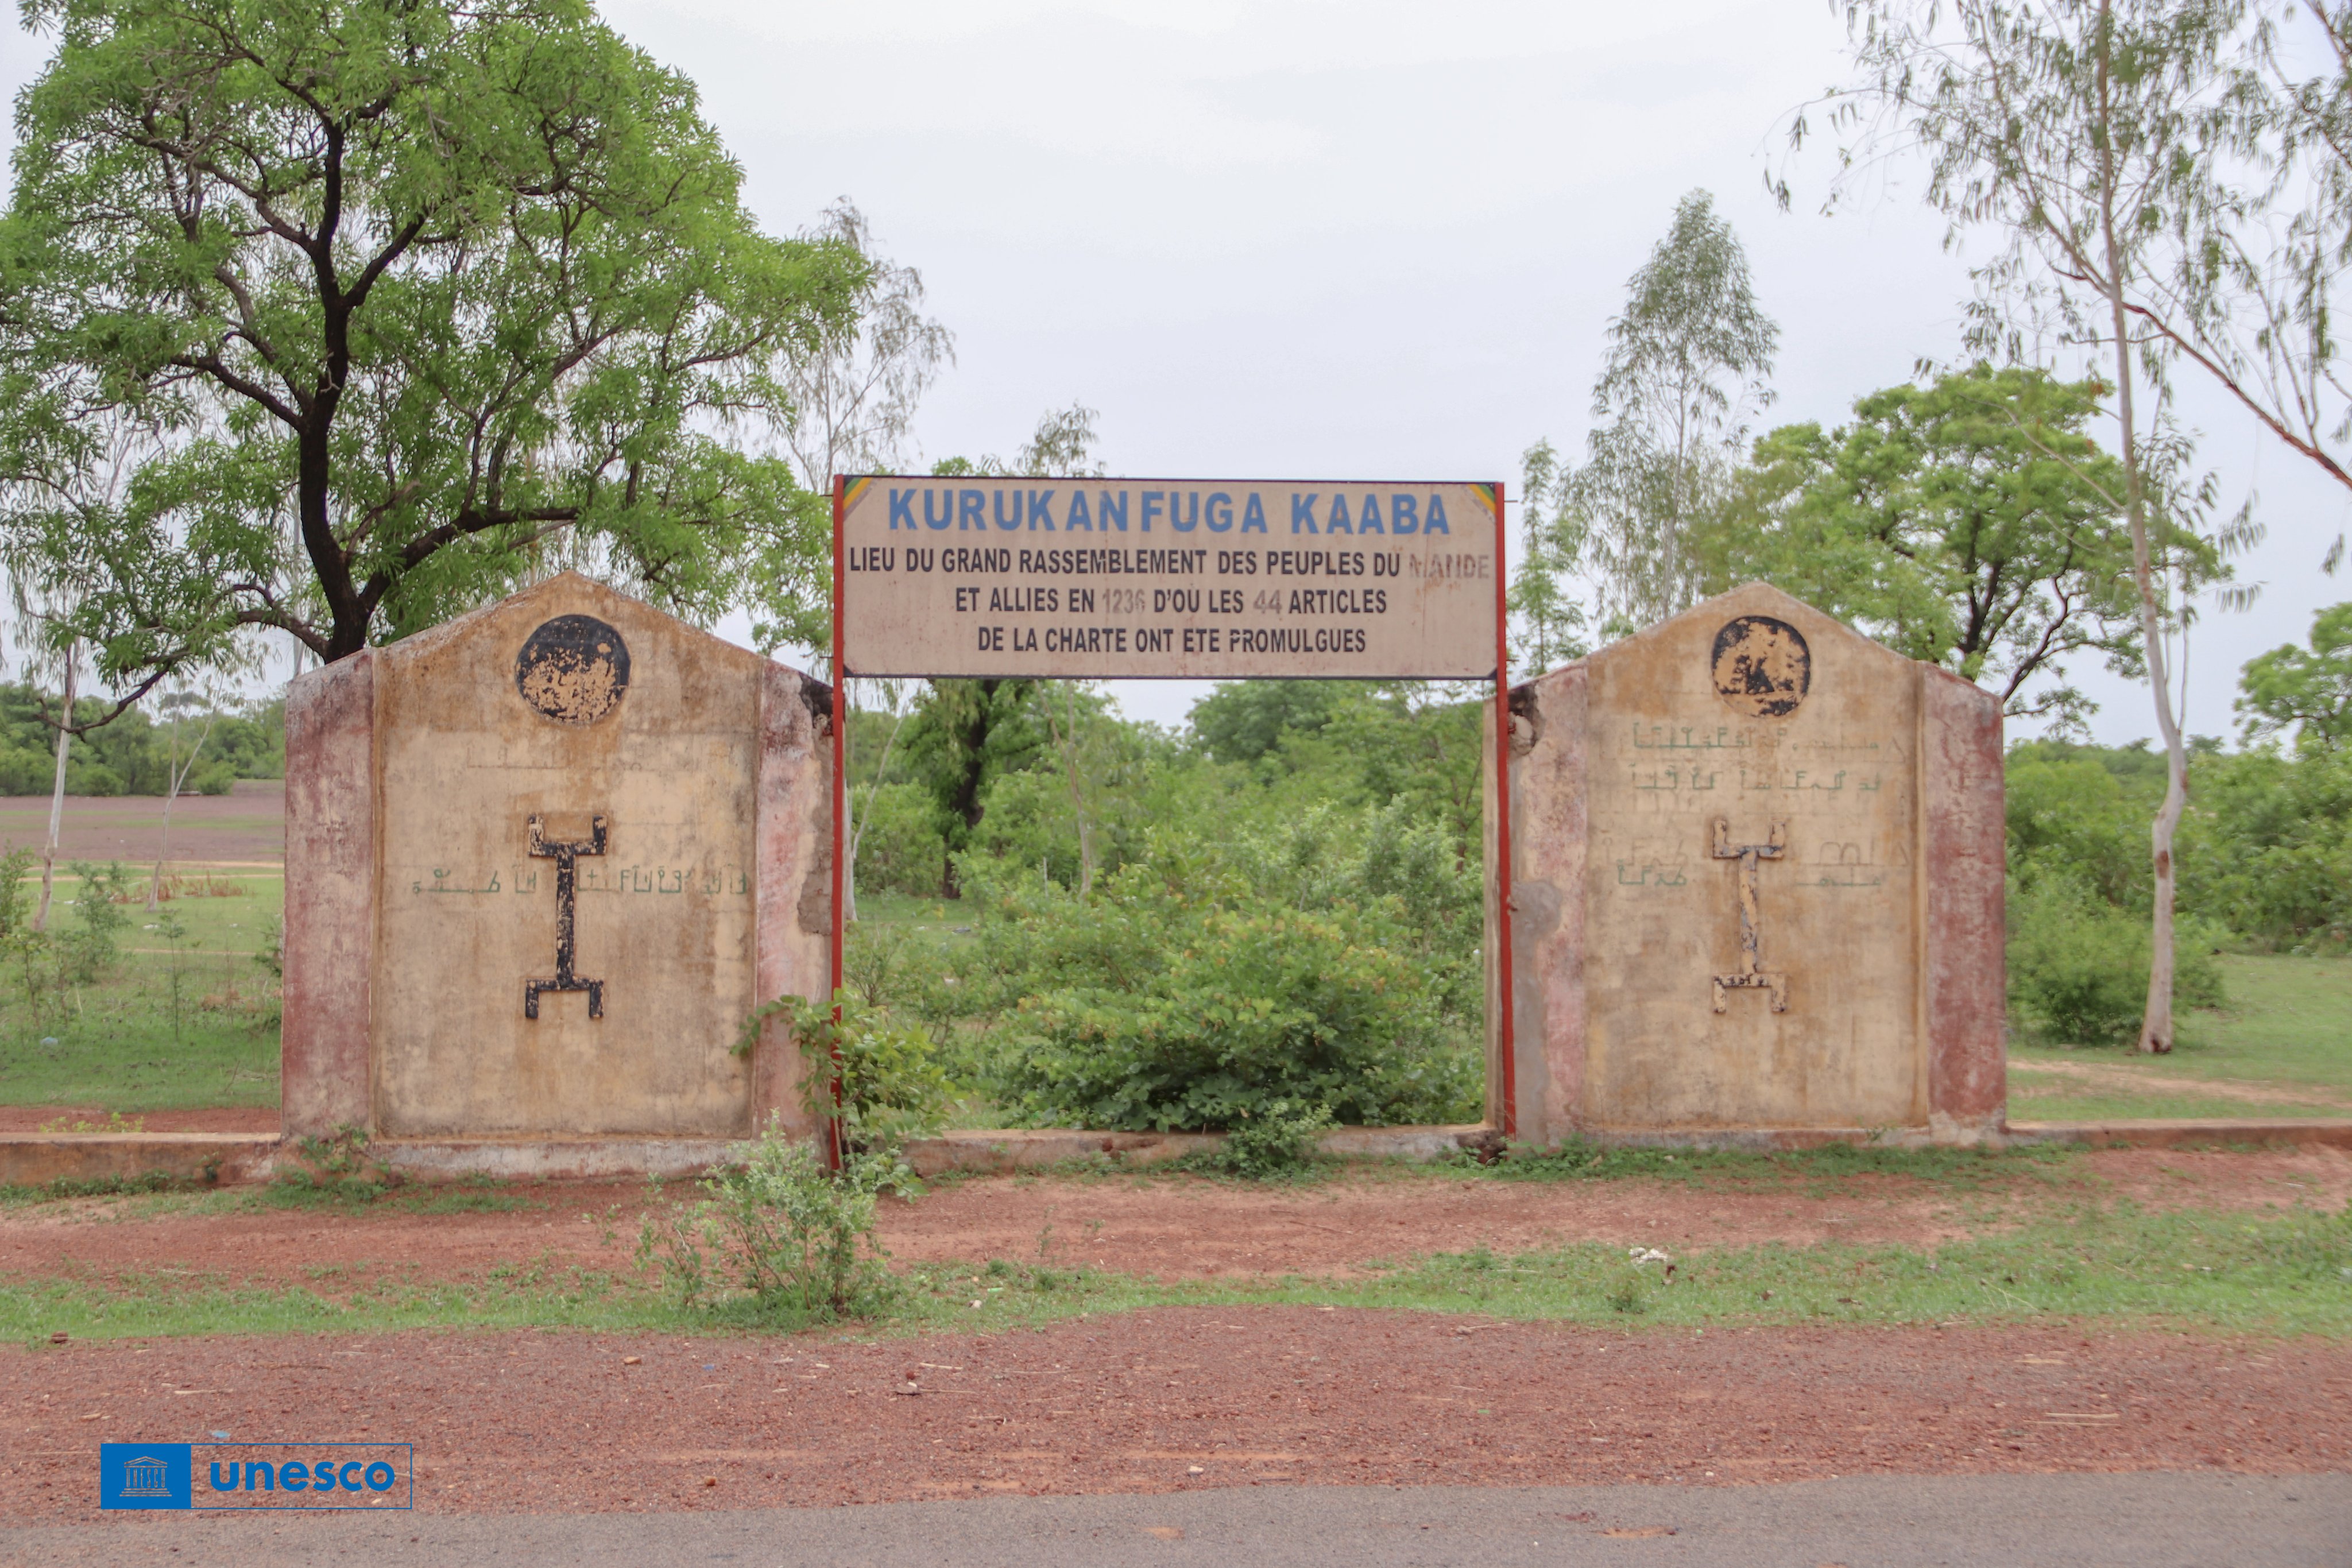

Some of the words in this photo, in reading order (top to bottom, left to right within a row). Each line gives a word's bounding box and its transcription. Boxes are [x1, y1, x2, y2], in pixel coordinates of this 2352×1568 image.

[889, 489, 1267, 533] KURUKANFUGA
[1292, 494, 1449, 534] KAABA
[851, 548, 894, 571] LIEU
[907, 548, 933, 572] DU
[942, 548, 1010, 572] GRAND
[1020, 549, 1206, 574] RASSEMBLEMENT
[1218, 551, 1256, 574] DES
[1267, 551, 1364, 575] PEUPLES
[1374, 553, 1399, 576] DU
[956, 587, 980, 611] ET
[990, 587, 1058, 611] ALLIES
[1069, 589, 1094, 613] EN
[1102, 589, 1145, 614] 1236
[1209, 590, 1243, 613] LES
[1254, 590, 1282, 614] 44
[1289, 589, 1386, 614] ARTICLES
[979, 627, 1003, 651] DE
[1014, 628, 1038, 651] LA
[1046, 628, 1126, 652] CHARTE
[1136, 629, 1173, 652] ONT
[1183, 629, 1220, 652] ETE
[1230, 629, 1365, 653] PROMULGUES
